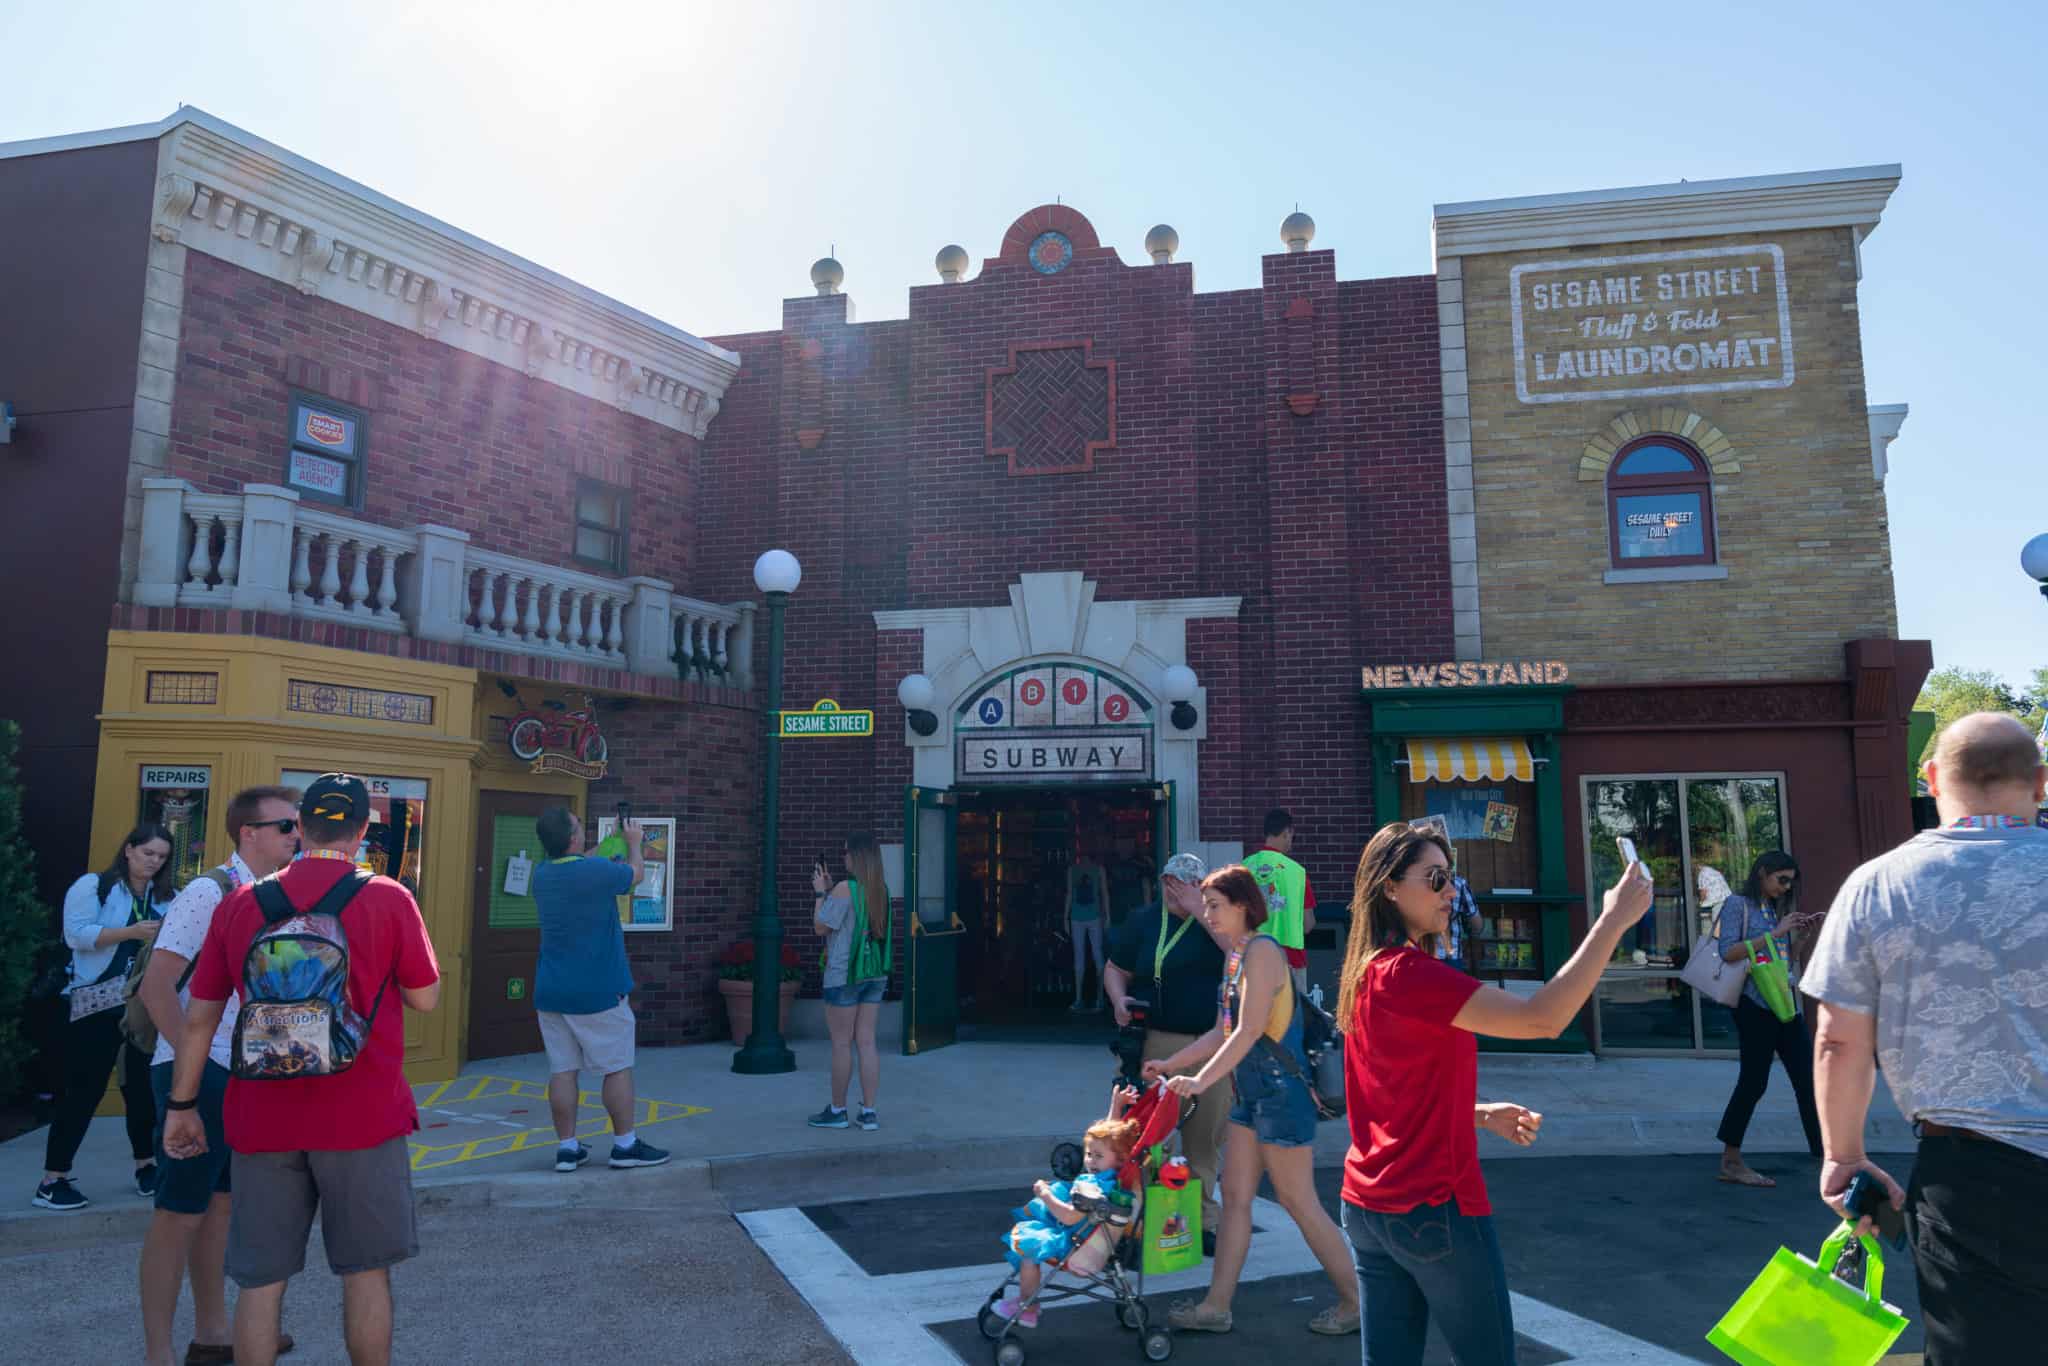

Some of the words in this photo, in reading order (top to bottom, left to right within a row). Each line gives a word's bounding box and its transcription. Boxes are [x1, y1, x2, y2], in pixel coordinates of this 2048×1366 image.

[1533, 276, 1643, 310] SESAME
[1656, 266, 1761, 300] STREET
[1578, 313, 1637, 340] Fluff
[1641, 312, 1658, 332] &
[1666, 308, 1721, 334] Fold
[1534, 337, 1776, 382] LAUNDROMAT
[312, 418, 341, 432] SMART
[1627, 513, 1661, 527] SESAME
[1662, 511, 1694, 525] STREET
[1648, 527, 1672, 539] DAILY
[1361, 661, 1569, 688] NEWSSTAND
[1027, 686, 1038, 700] B
[1072, 685, 1078, 699] 1
[985, 704, 997, 718] A
[1112, 703, 1121, 716] 2
[785, 716, 826, 732] SESAME
[829, 715, 867, 731] STREET
[983, 746, 1124, 769] SUBWAY
[147, 771, 206, 783] REPAIRS
